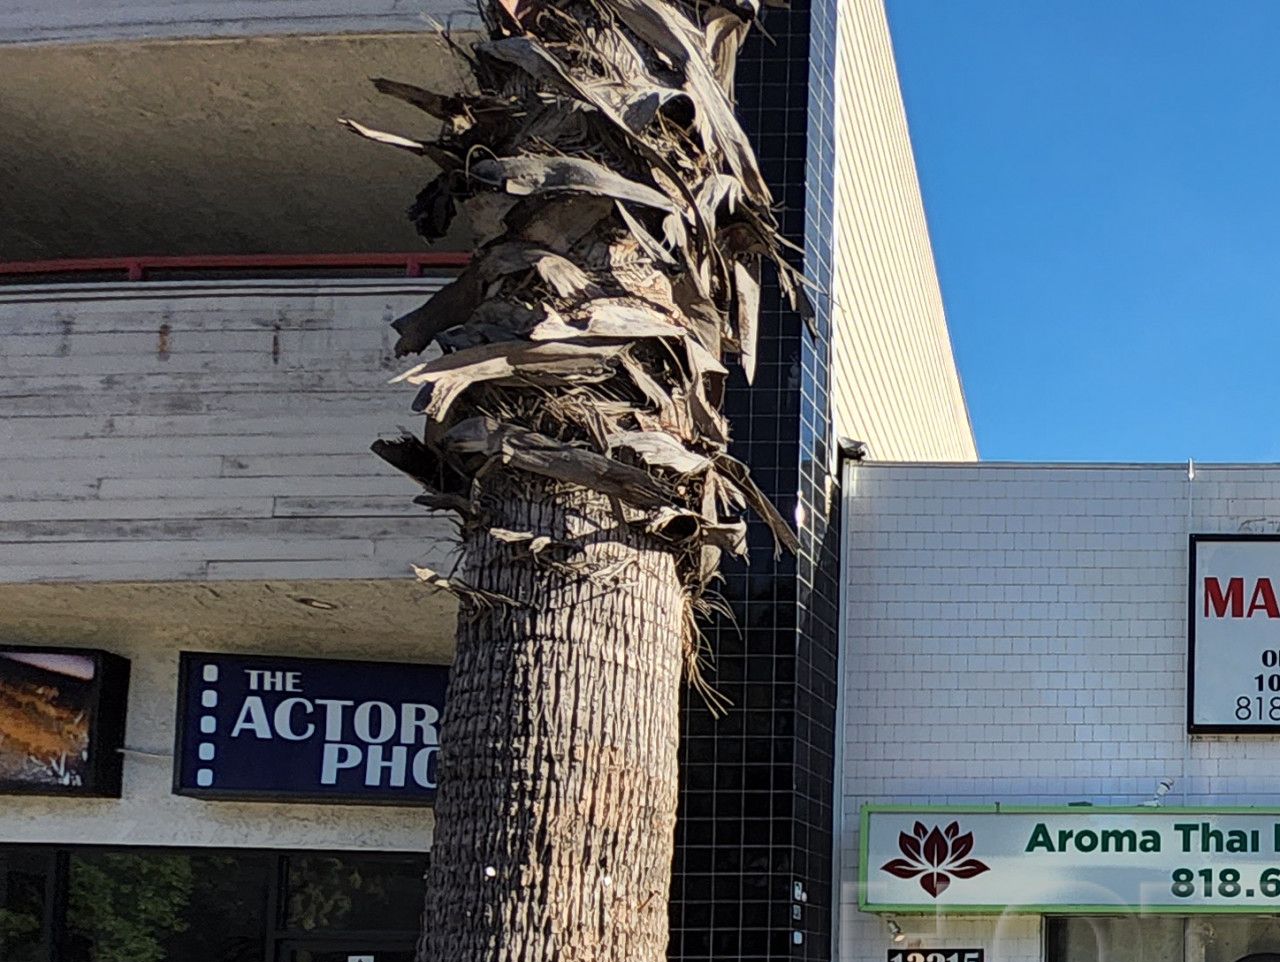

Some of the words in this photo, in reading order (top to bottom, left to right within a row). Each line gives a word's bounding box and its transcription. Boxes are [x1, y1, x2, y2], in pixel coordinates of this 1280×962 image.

[244, 669, 304, 692] THE
[1025, 823, 1161, 853] Aroma
[1174, 822, 1259, 853] Thai
